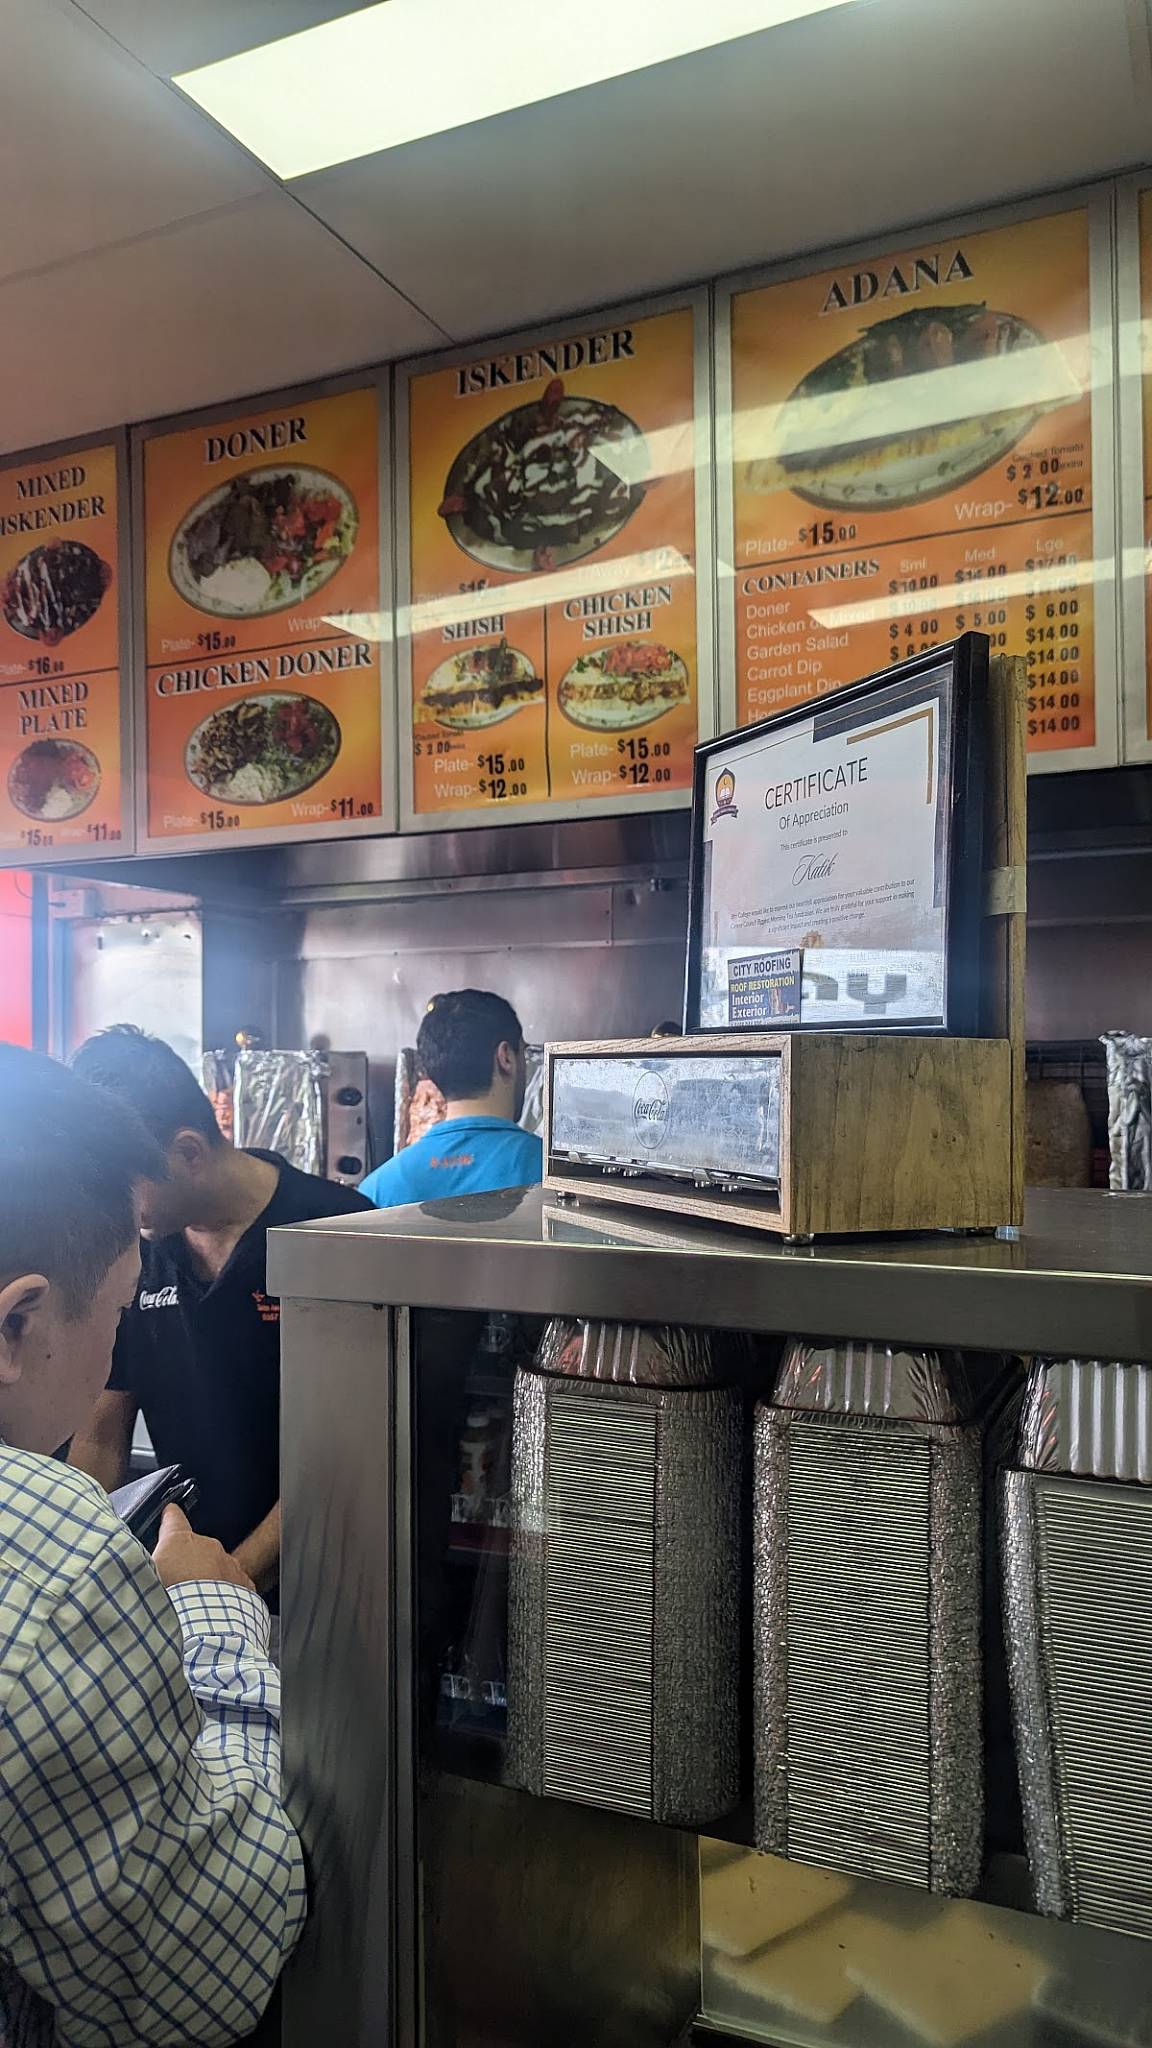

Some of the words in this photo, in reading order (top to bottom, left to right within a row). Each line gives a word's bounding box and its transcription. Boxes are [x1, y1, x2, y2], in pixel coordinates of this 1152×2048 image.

[818, 249, 975, 314] ADANA
[455, 328, 635, 398] ISKENDER
[204, 415, 308, 465] DONER
[16, 466, 86, 499] MIXED
[1017, 482, 1083, 510] $12.00
[0, 495, 106, 536] ISKENDER
[798, 521, 857, 546] $15.00
[742, 558, 880, 596] CONTAINERS
[964, 547, 996, 562] Med
[563, 584, 673, 621] CHICKEN
[746, 600, 791, 619] Doner
[442, 615, 504, 643] SHISH
[582, 611, 653, 641] SHISH
[746, 618, 806, 640] Chicken
[197, 632, 236, 651] $15.00
[747, 641, 801, 661] Garden
[806, 633, 849, 652] Salad
[156, 657, 271, 698] CHICKEN
[276, 642, 374, 680] DONER
[747, 663, 793, 682] Carrot
[797, 659, 823, 676] Dip
[18, 681, 88, 710] MIXED
[747, 683, 813, 704] Eggplant
[19, 706, 88, 737] PLATE
[1027, 715, 1080, 736] $14.00
[617, 737, 671, 760] $15.00
[434, 759, 474, 774] Plate-
[477, 754, 525, 775] $15.00
[571, 769, 616, 785] Wrap-
[618, 762, 671, 785] $12.00
[434, 784, 477, 799] Wrap-
[478, 779, 527, 799] $12.00
[765, 756, 868, 810] CERTIFICATE
[200, 810, 240, 829] $15.00
[290, 801, 330, 818] Wrap-
[330, 797, 374, 818] $11.00
[779, 814, 791, 830] Of
[792, 801, 849, 828] Appreciation
[780, 843, 790, 851] This
[790, 837, 812, 849] certificate
[818, 828, 842, 844] presented
[842, 829, 848, 837] to
[733, 963, 752, 977] CITY
[754, 957, 791, 974] ROOFING
[730, 981, 747, 992] ROOF
[749, 975, 795, 991] RESTORATION
[732, 991, 765, 1006] Interior
[732, 1004, 768, 1019] Exterior
